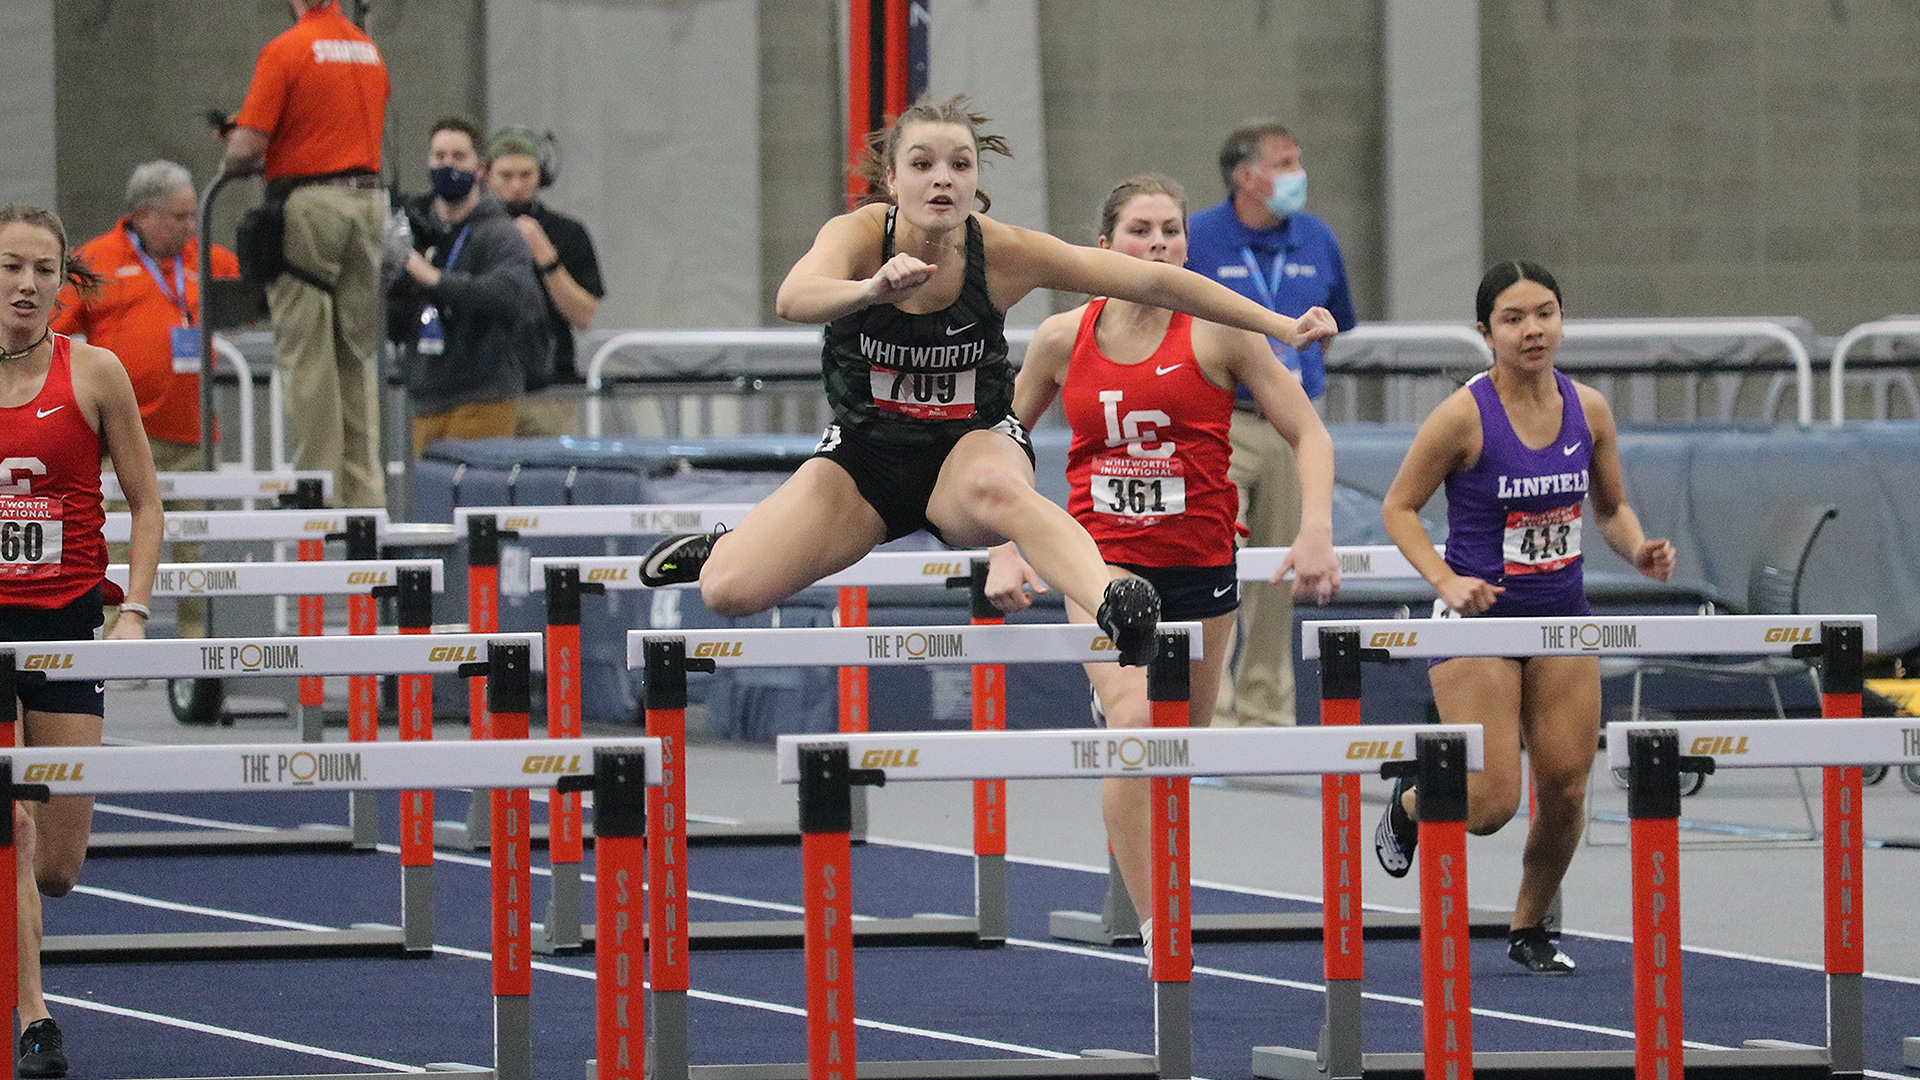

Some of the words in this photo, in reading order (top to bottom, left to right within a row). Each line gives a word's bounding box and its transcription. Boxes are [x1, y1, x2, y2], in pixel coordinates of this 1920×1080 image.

[860, 332, 985, 368] WHITWORTH
[1100, 466, 1173, 476] INVITATIONAL
[1105, 459, 1170, 468] WHITWORTH
[1497, 469, 1590, 498] LINFIELD
[1108, 478, 1167, 514] 361
[0, 509, 52, 518] ATIONAL
[1, 521, 44, 562] 60
[1520, 525, 1571, 560] 413
[347, 571, 388, 585] GILL
[588, 568, 628, 581] GILL
[922, 562, 963, 576] GILL
[1090, 636, 1119, 651] GI
[1369, 631, 1418, 648] GILL
[1541, 625, 1565, 649] THE
[1764, 627, 1814, 643] GILL
[428, 646, 478, 662] GILL
[694, 641, 744, 657] GILL
[866, 634, 891, 659] THE
[24, 653, 75, 670] GILL
[200, 646, 225, 670] THE
[1071, 740, 1101, 769] THE
[1345, 740, 1406, 760] GILL
[1690, 736, 1750, 756] GILL
[241, 754, 271, 783] THE
[521, 755, 582, 774] GILL
[861, 748, 920, 769] GILL
[22, 762, 84, 782] GILL
[661, 736, 677, 966] SPOKANE
[615, 870, 630, 1080] SPOKA
[823, 864, 841, 1080] SPOKA
